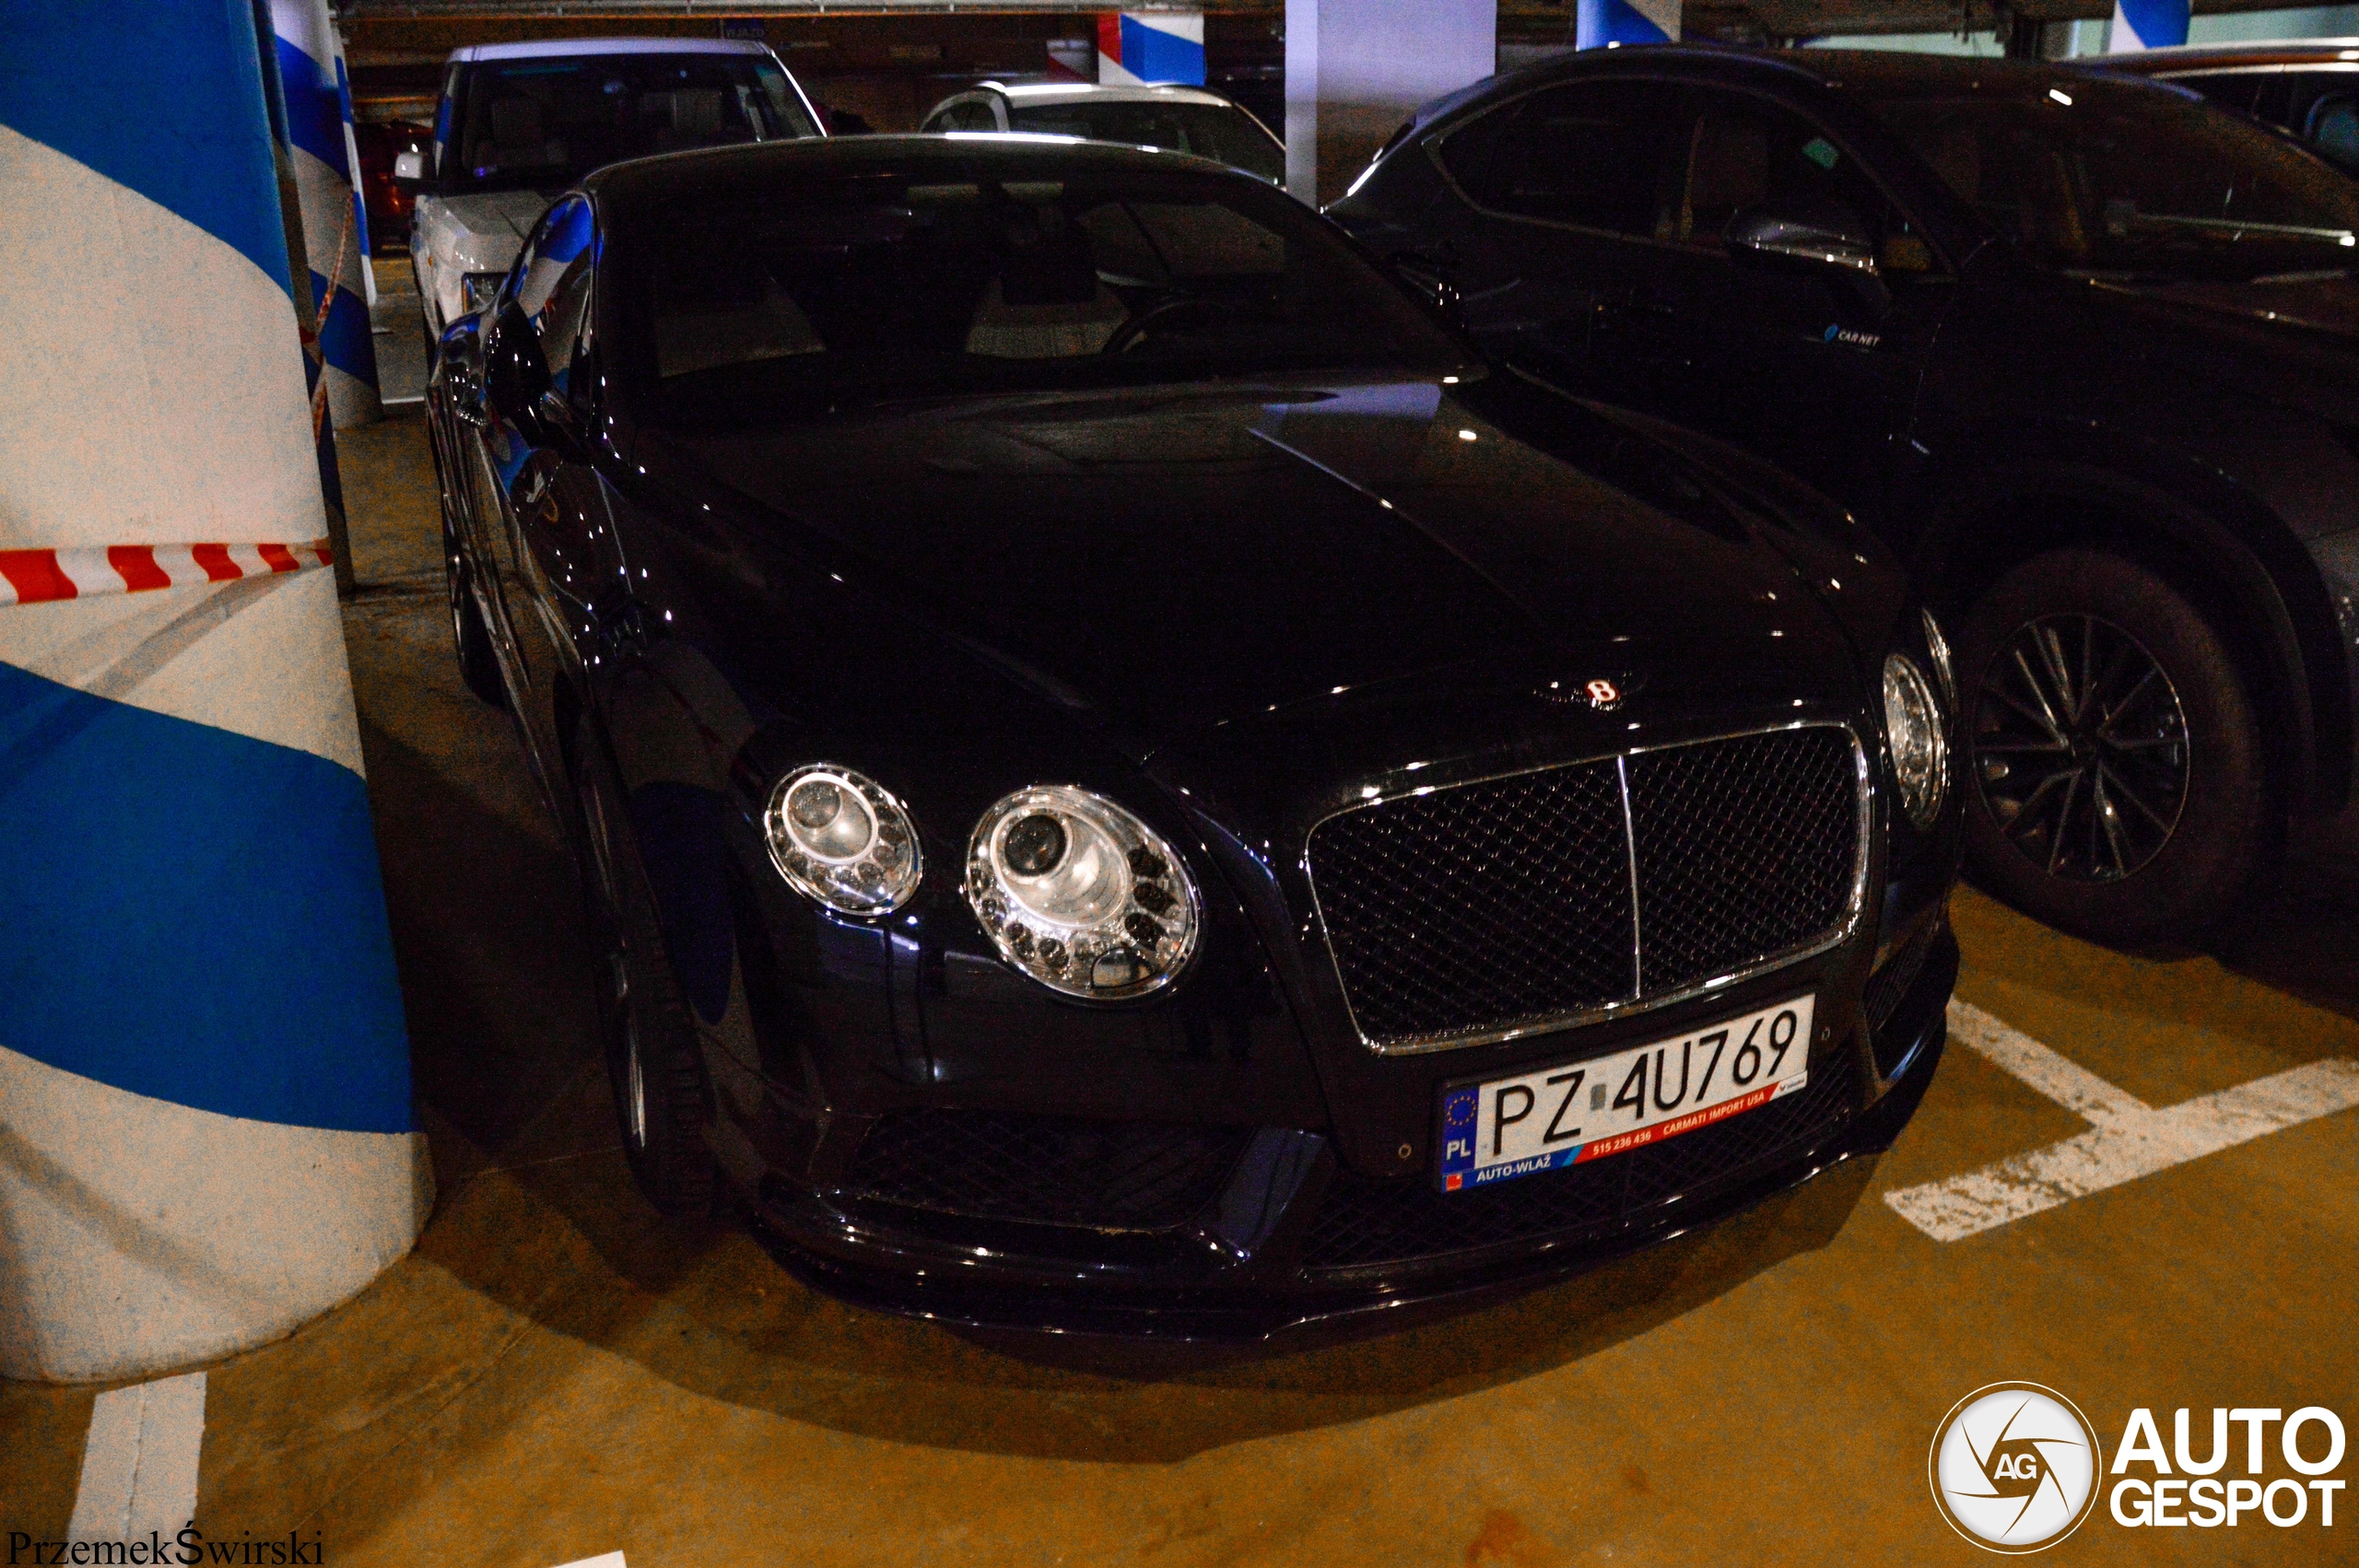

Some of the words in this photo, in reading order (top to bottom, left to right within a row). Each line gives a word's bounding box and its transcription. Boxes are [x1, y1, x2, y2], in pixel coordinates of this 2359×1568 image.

[1492, 1069, 1587, 1156] PZ
[1612, 1009, 1797, 1120] 4U769
[1446, 1139, 1472, 1161] PL
[1592, 1142, 1612, 1156] 515
[1662, 1113, 1707, 1136] CARMATI
[1708, 1100, 1744, 1121] IMPORT
[1747, 1091, 1766, 1106] USA
